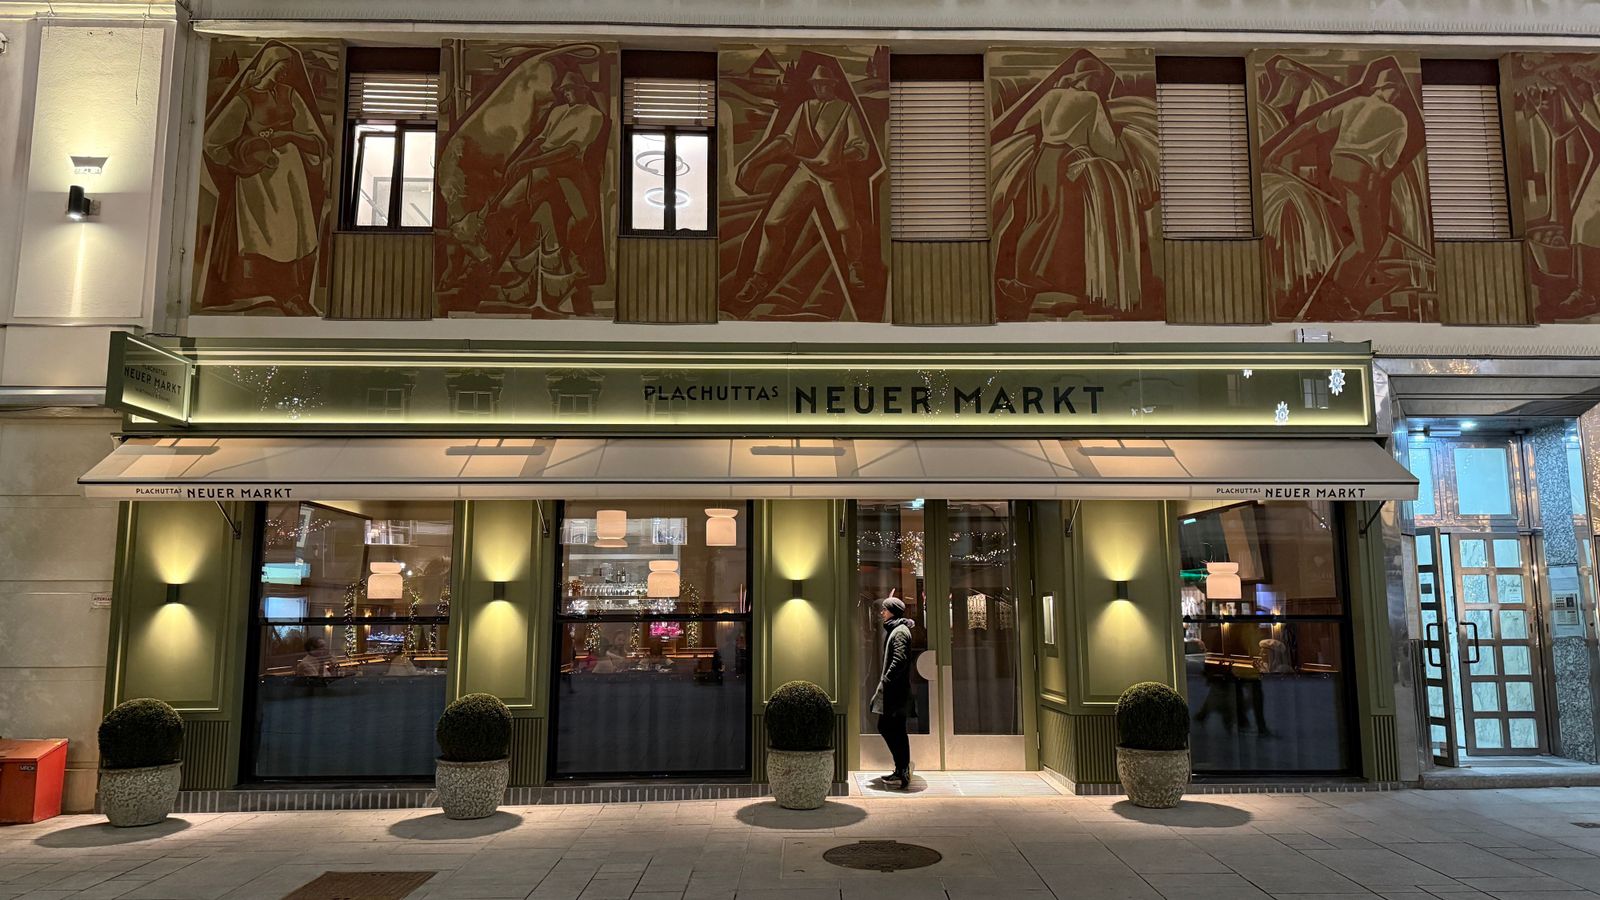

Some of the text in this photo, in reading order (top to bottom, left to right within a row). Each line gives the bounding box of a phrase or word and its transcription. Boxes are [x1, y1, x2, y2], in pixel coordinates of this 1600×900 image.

[124, 367, 151, 384] NEUER
[154, 377, 182, 395] MARKT
[643, 385, 1105, 414] PLACHUTTAS NEUER MARKT
[136, 487, 292, 499] PLACHUTTAS NEUER MARKT
[1265, 488, 1311, 498] NEUER
[1316, 488, 1366, 498] MARKT
